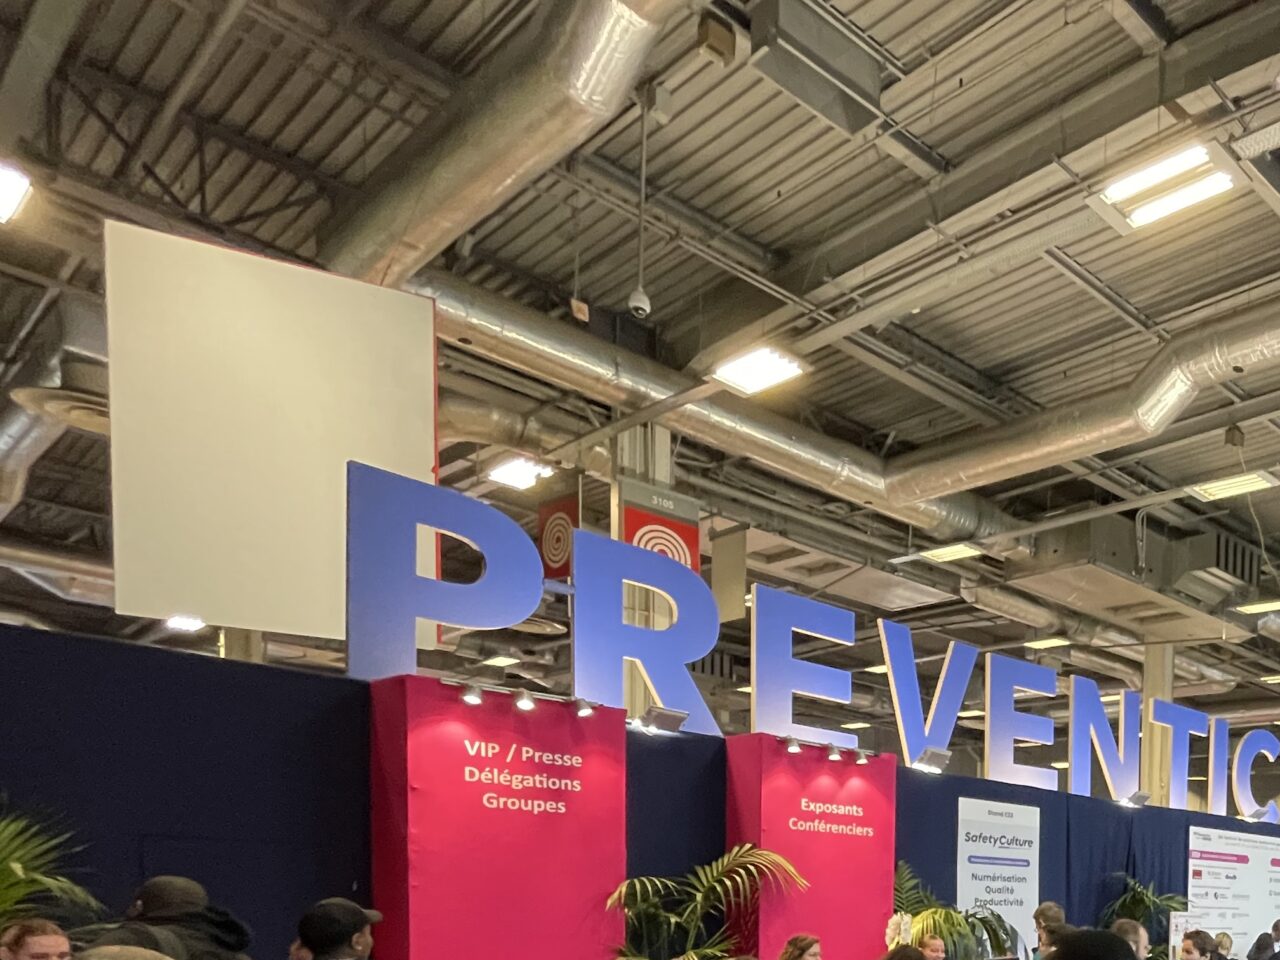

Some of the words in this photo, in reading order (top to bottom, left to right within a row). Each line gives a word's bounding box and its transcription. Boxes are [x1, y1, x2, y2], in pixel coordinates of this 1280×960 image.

[651, 495, 674, 509] 3105
[464, 739, 500, 758] VIP
[521, 746, 583, 768] Presse
[464, 766, 582, 792] Délégations
[482, 792, 567, 815] Groupes
[801, 798, 864, 817] Exposants
[788, 817, 874, 837] Conférenciers
[964, 831, 1034, 848] SafetyCulture
[971, 872, 1027, 884] Numérisation
[985, 885, 1014, 895] Qualité
[974, 897, 1024, 907] Productivité
